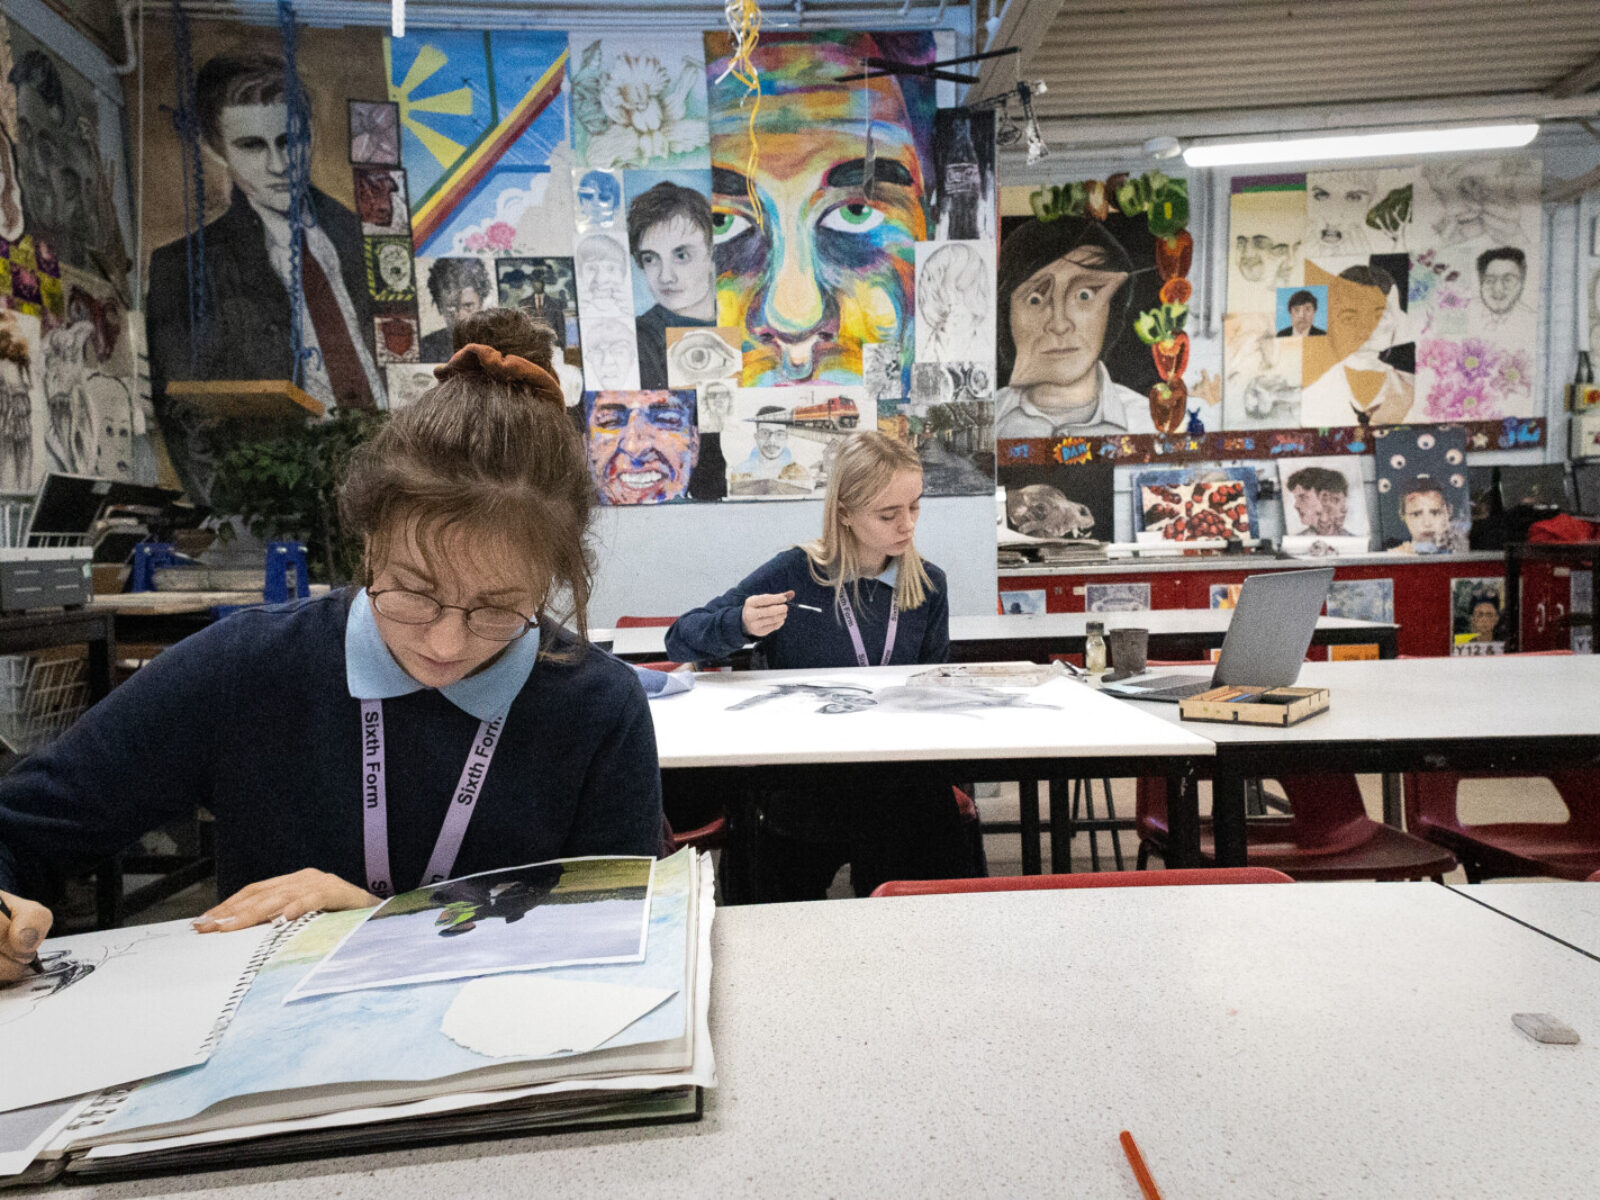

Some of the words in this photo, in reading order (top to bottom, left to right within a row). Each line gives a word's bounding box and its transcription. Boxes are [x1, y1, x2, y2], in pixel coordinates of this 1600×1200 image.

[365, 711, 380, 756] Sixth
[457, 763, 485, 806] Sixth
[475, 716, 503, 758] Form
[366, 762, 380, 809] Form
